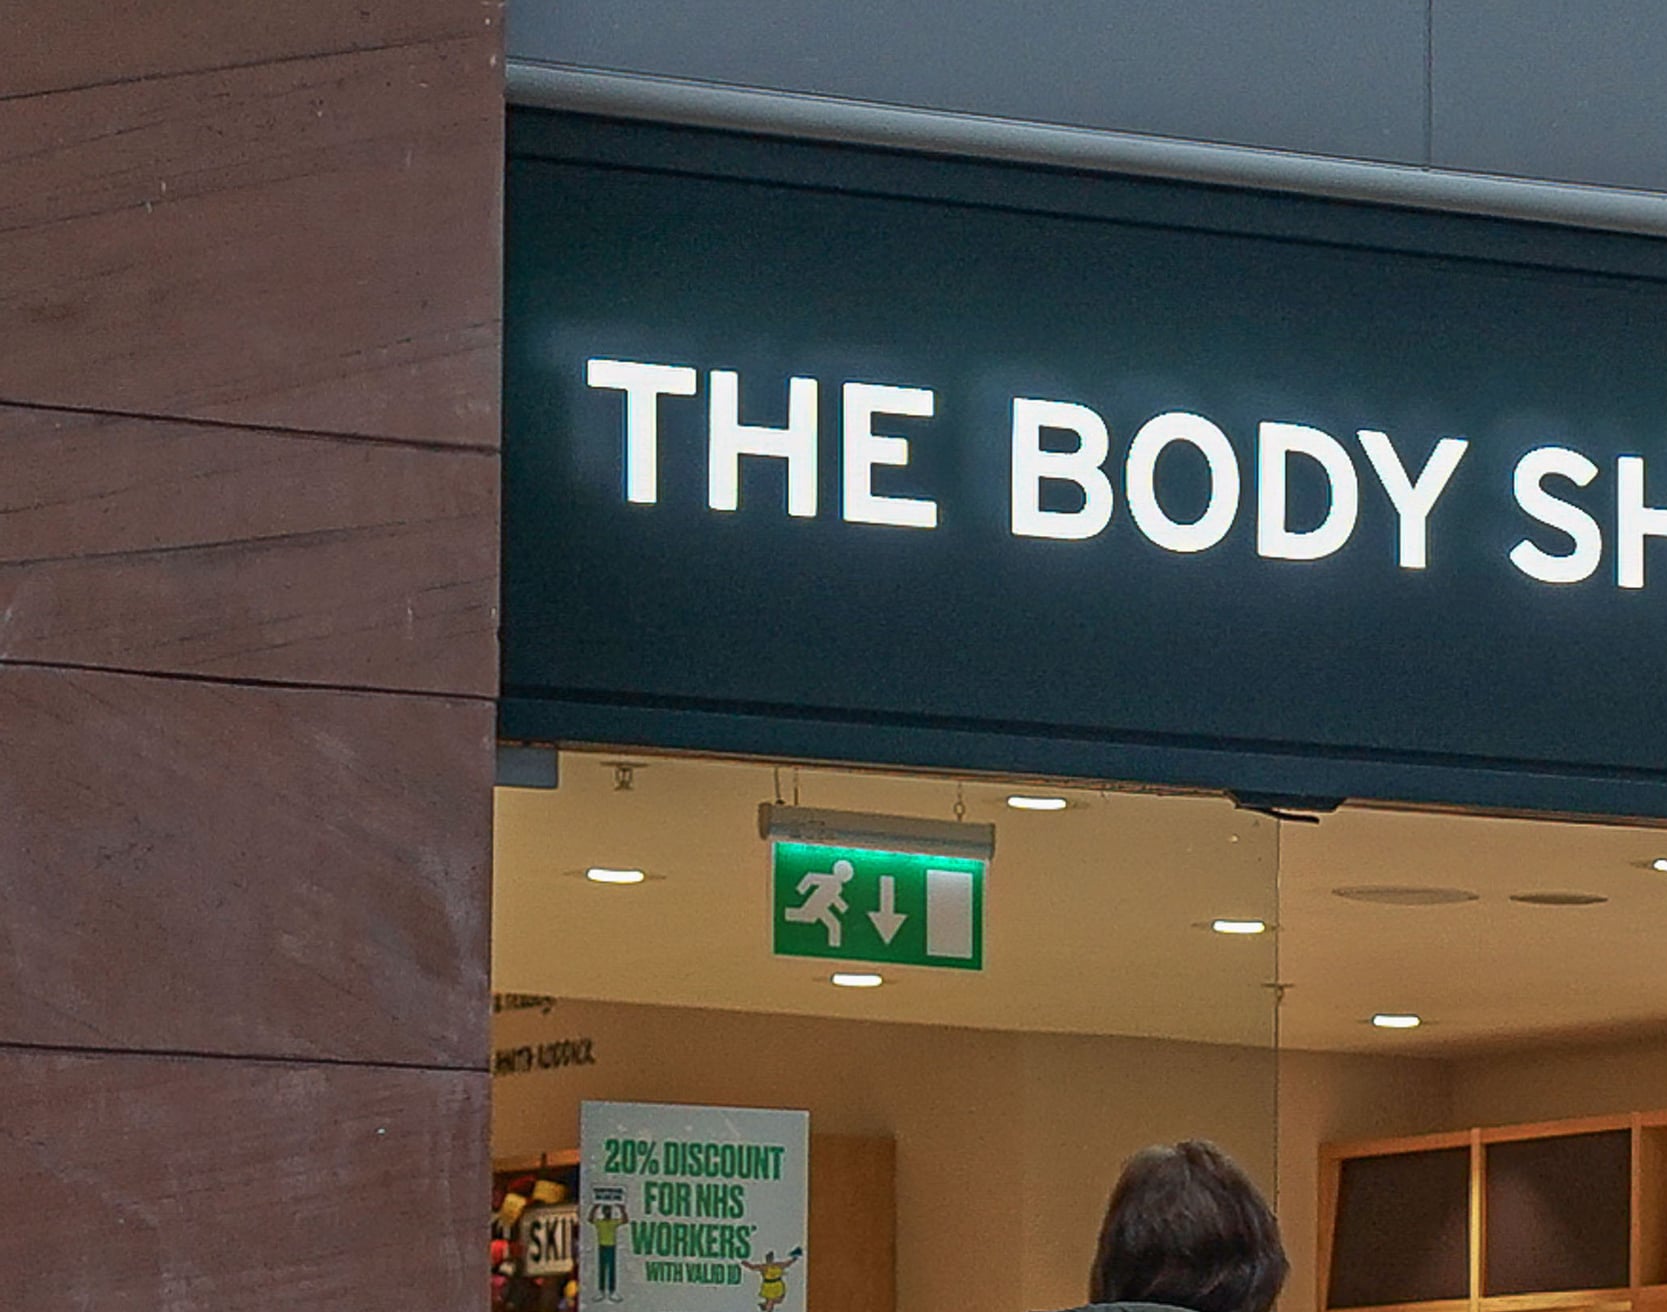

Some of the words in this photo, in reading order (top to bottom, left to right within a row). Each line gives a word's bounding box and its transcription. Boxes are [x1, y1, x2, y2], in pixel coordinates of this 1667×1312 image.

[585, 358, 938, 530] THE
[1010, 397, 1468, 570] BODY
[603, 1138, 661, 1176] 20%
[663, 1140, 786, 1181] DISCOUNT
[643, 1180, 692, 1218] FOR
[695, 1182, 746, 1220] NHS
[645, 1260, 684, 1284] WITH
[685, 1261, 727, 1285] VALID
[727, 1262, 742, 1286] ID
